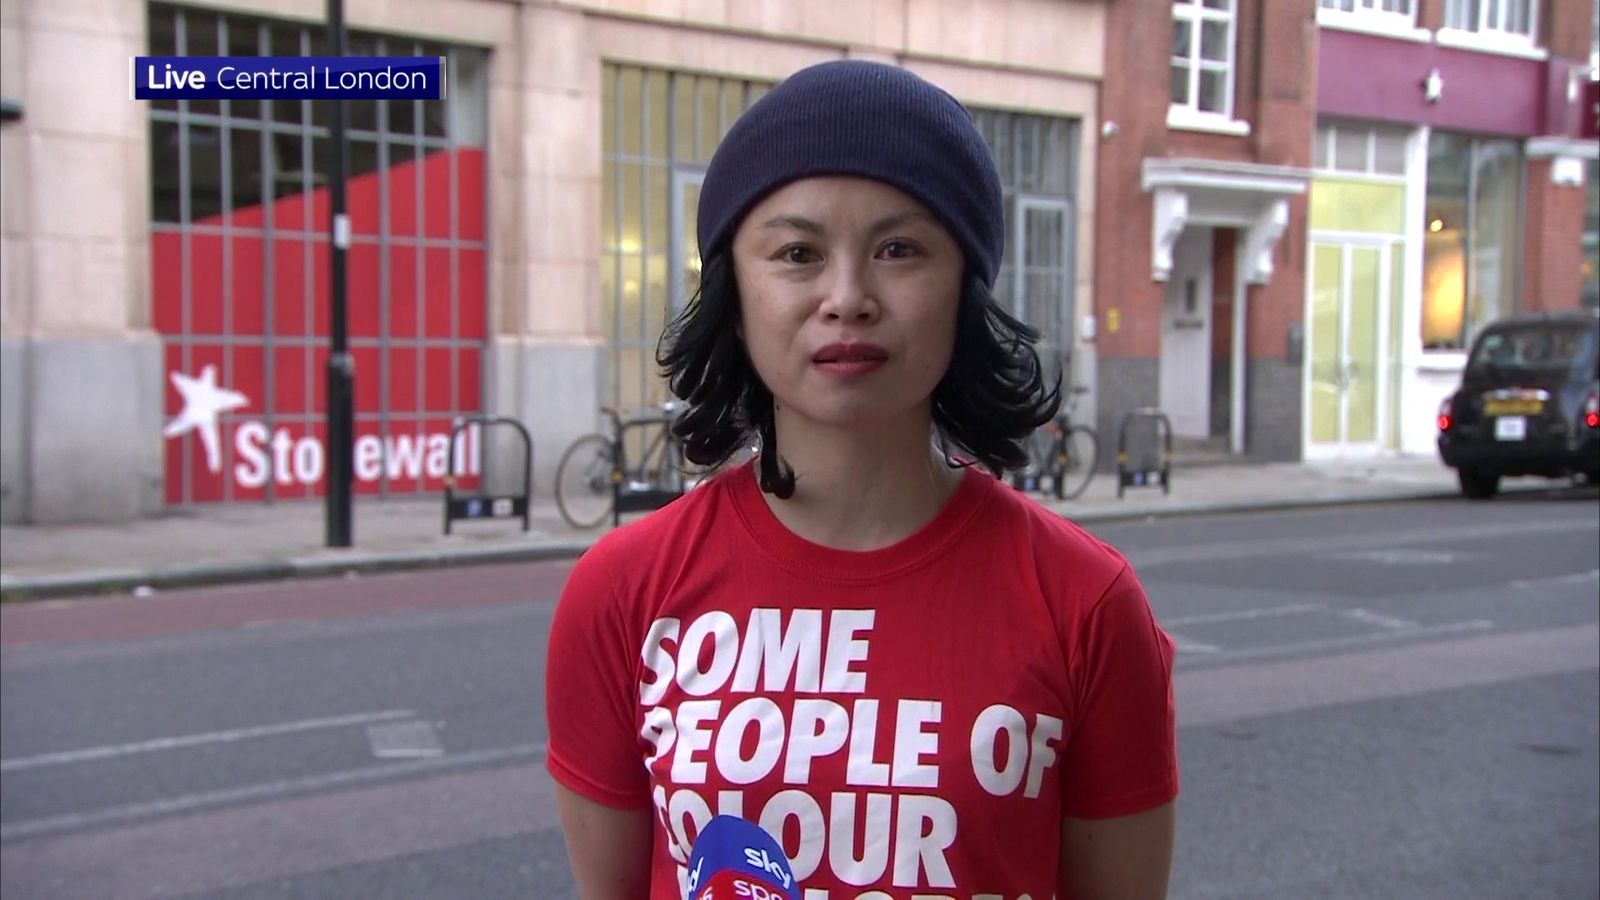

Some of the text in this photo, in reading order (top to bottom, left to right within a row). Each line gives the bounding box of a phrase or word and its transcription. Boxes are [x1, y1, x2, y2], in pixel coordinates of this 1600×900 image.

[234, 420, 481, 488] Stoewall
[639, 607, 876, 706] SOME
[640, 697, 1064, 798] PEOPLE OF
[744, 847, 792, 890] sky
